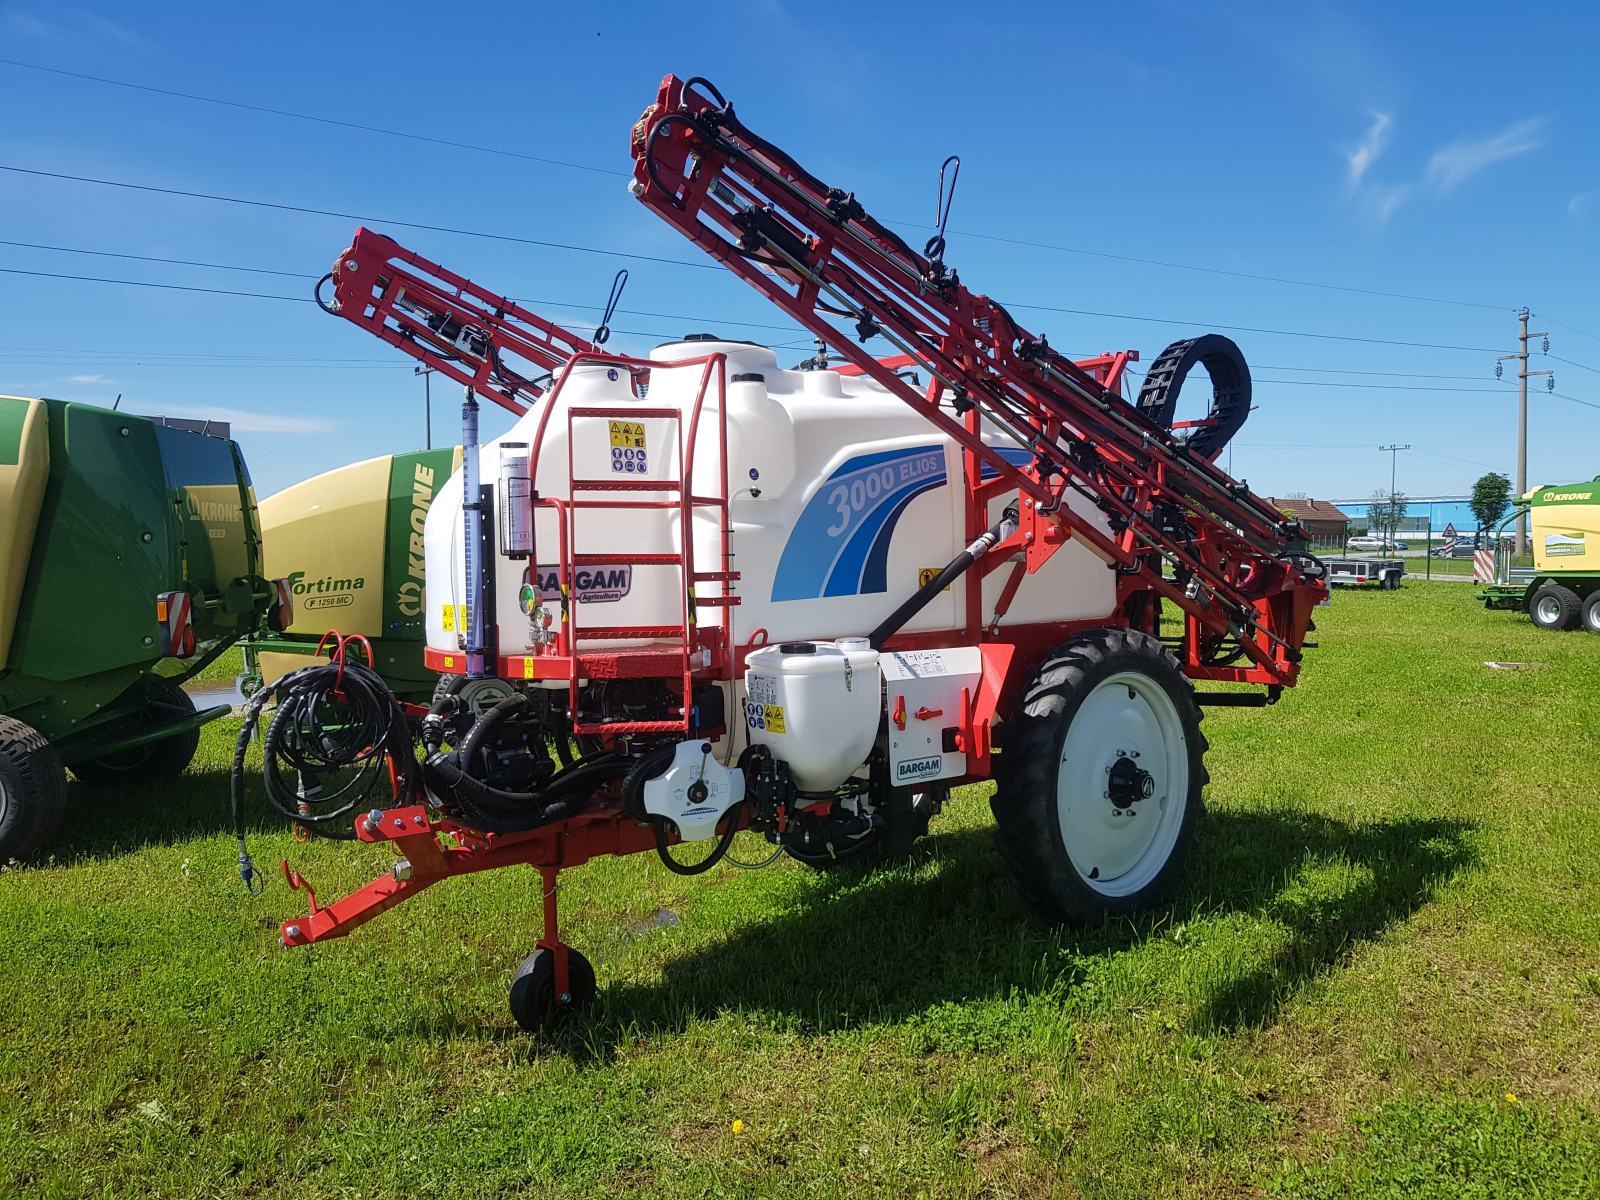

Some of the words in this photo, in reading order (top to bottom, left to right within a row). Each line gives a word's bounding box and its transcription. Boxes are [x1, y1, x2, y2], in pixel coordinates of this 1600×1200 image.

[826, 467, 895, 537] 3000
[900, 457, 937, 481] ELIOS
[1553, 493, 1592, 501] KRONE
[408, 463, 434, 580] KRONE
[288, 571, 365, 595] Fortima
[318, 598, 335, 607] 1250
[336, 597, 349, 605] MC
[582, 593, 619, 602] Agriculture
[900, 760, 939, 775] BARGAM
